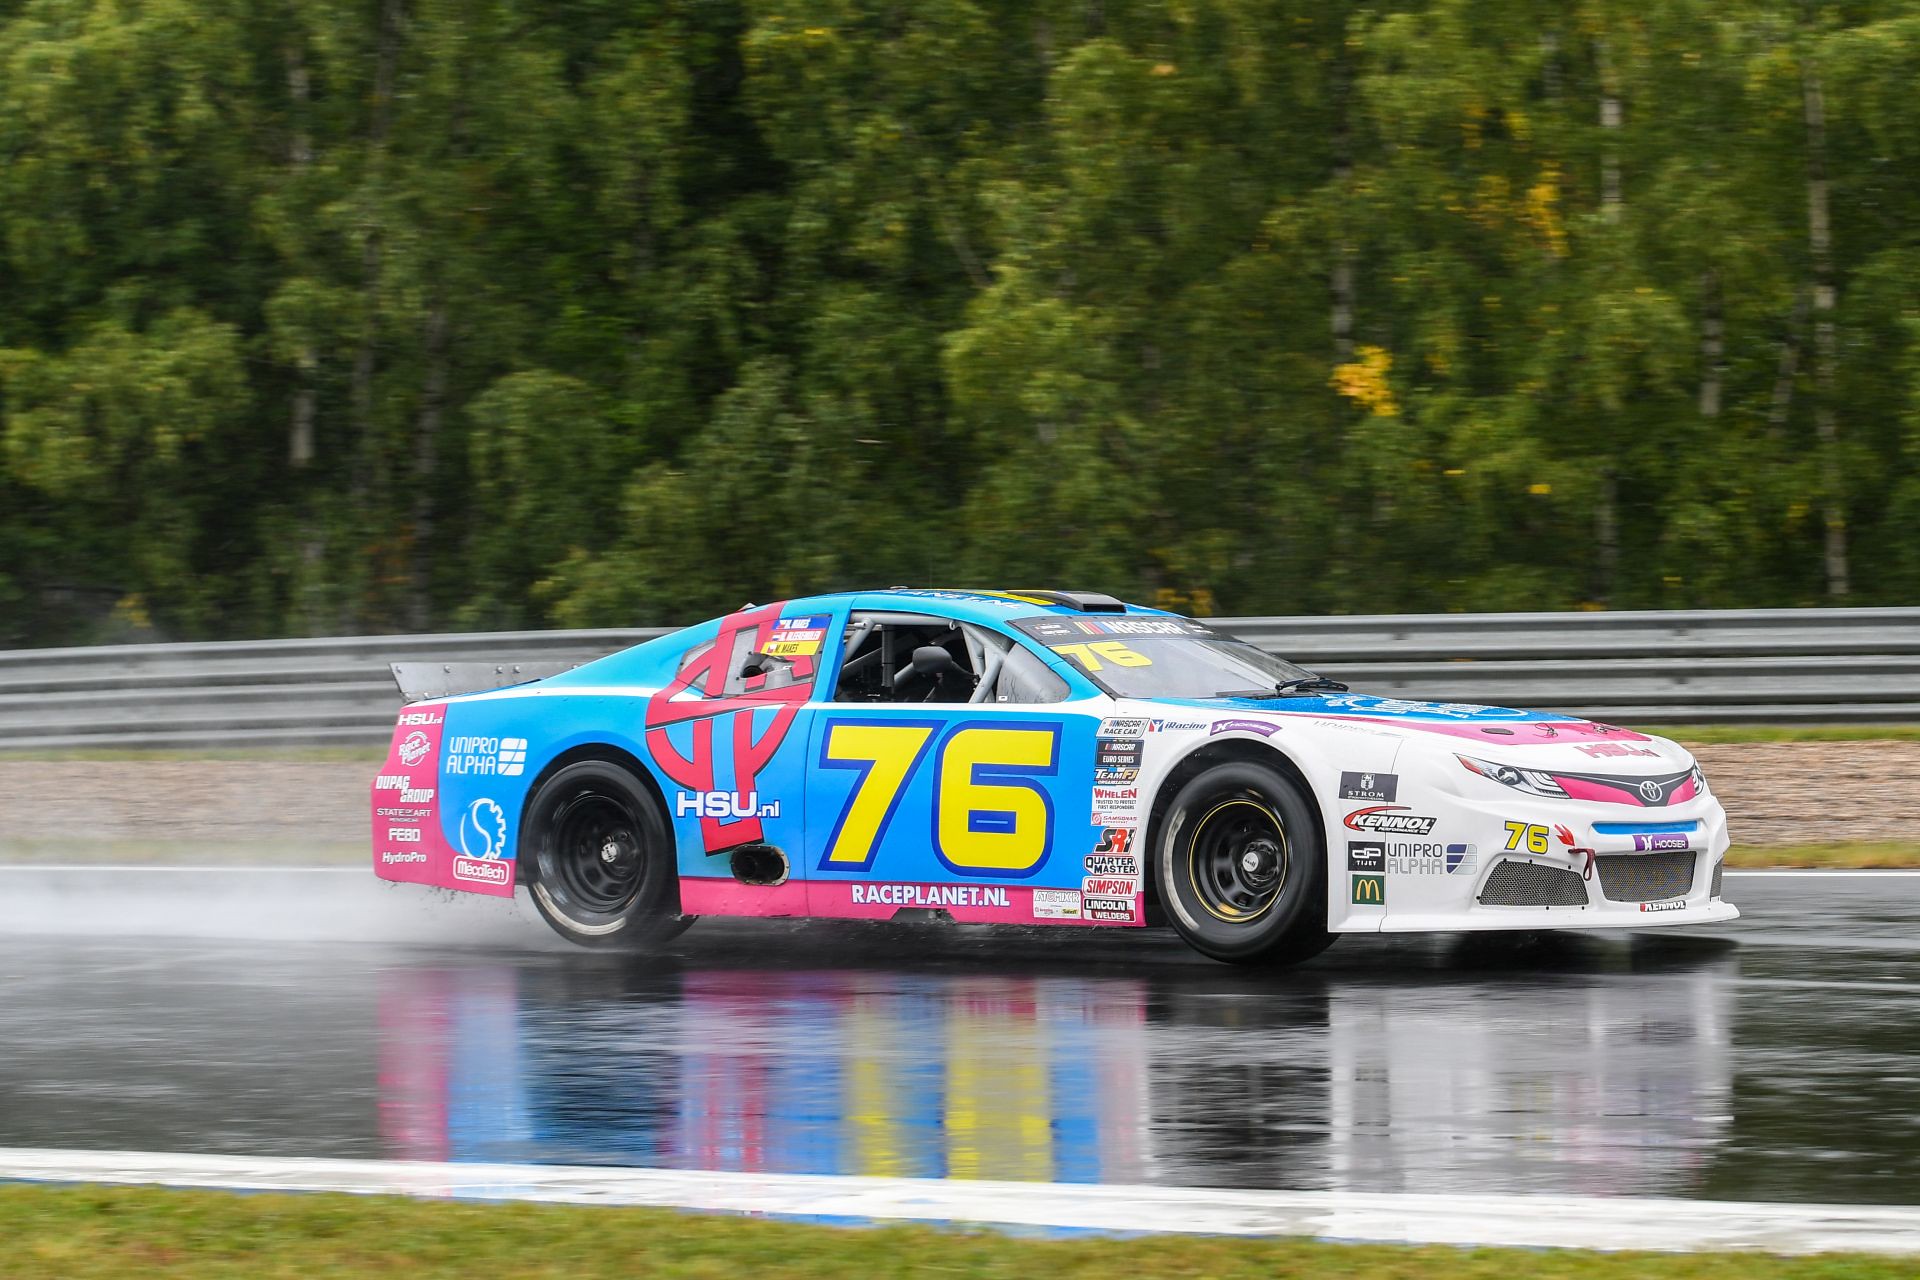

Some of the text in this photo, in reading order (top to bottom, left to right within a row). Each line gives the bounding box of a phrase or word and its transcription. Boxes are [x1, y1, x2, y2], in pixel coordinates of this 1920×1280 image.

[1101, 621, 1190, 635] NASCAR
[1050, 641, 1153, 672] 76
[397, 712, 444, 726] HSU.nl
[1114, 720, 1142, 728] NASCAR
[1164, 721, 1207, 730] iRacing
[449, 736, 499, 755] UNIPRO
[1112, 743, 1136, 751] NASCAR
[446, 755, 497, 775] ALPHA
[1102, 755, 1135, 763] EURO SERIES
[375, 776, 411, 790] DUPAG
[400, 789, 435, 803] GROUP
[816, 717, 1064, 880] 76
[1093, 787, 1138, 799] WHELEN
[1347, 790, 1385, 798] STROM
[676, 790, 780, 818] HSU.nl
[376, 807, 404, 816] STATE
[413, 809, 433, 817] ART
[1350, 814, 1432, 830] KENNOL
[388, 827, 421, 842] FEBO
[1504, 820, 1550, 855] 76
[1387, 843, 1443, 858] UNIPRO
[1654, 838, 1687, 850] HOOSIER
[382, 851, 427, 865] HydroPro
[1085, 856, 1134, 869] QUARTER
[1094, 865, 1136, 874] MASTER
[1387, 858, 1444, 875] ALPHA
[1086, 879, 1133, 895] SIMPSON
[851, 884, 1011, 907] RACEPLANET.NL
[1085, 900, 1126, 911] LINCOLN
[1095, 911, 1131, 921] WELDERS
